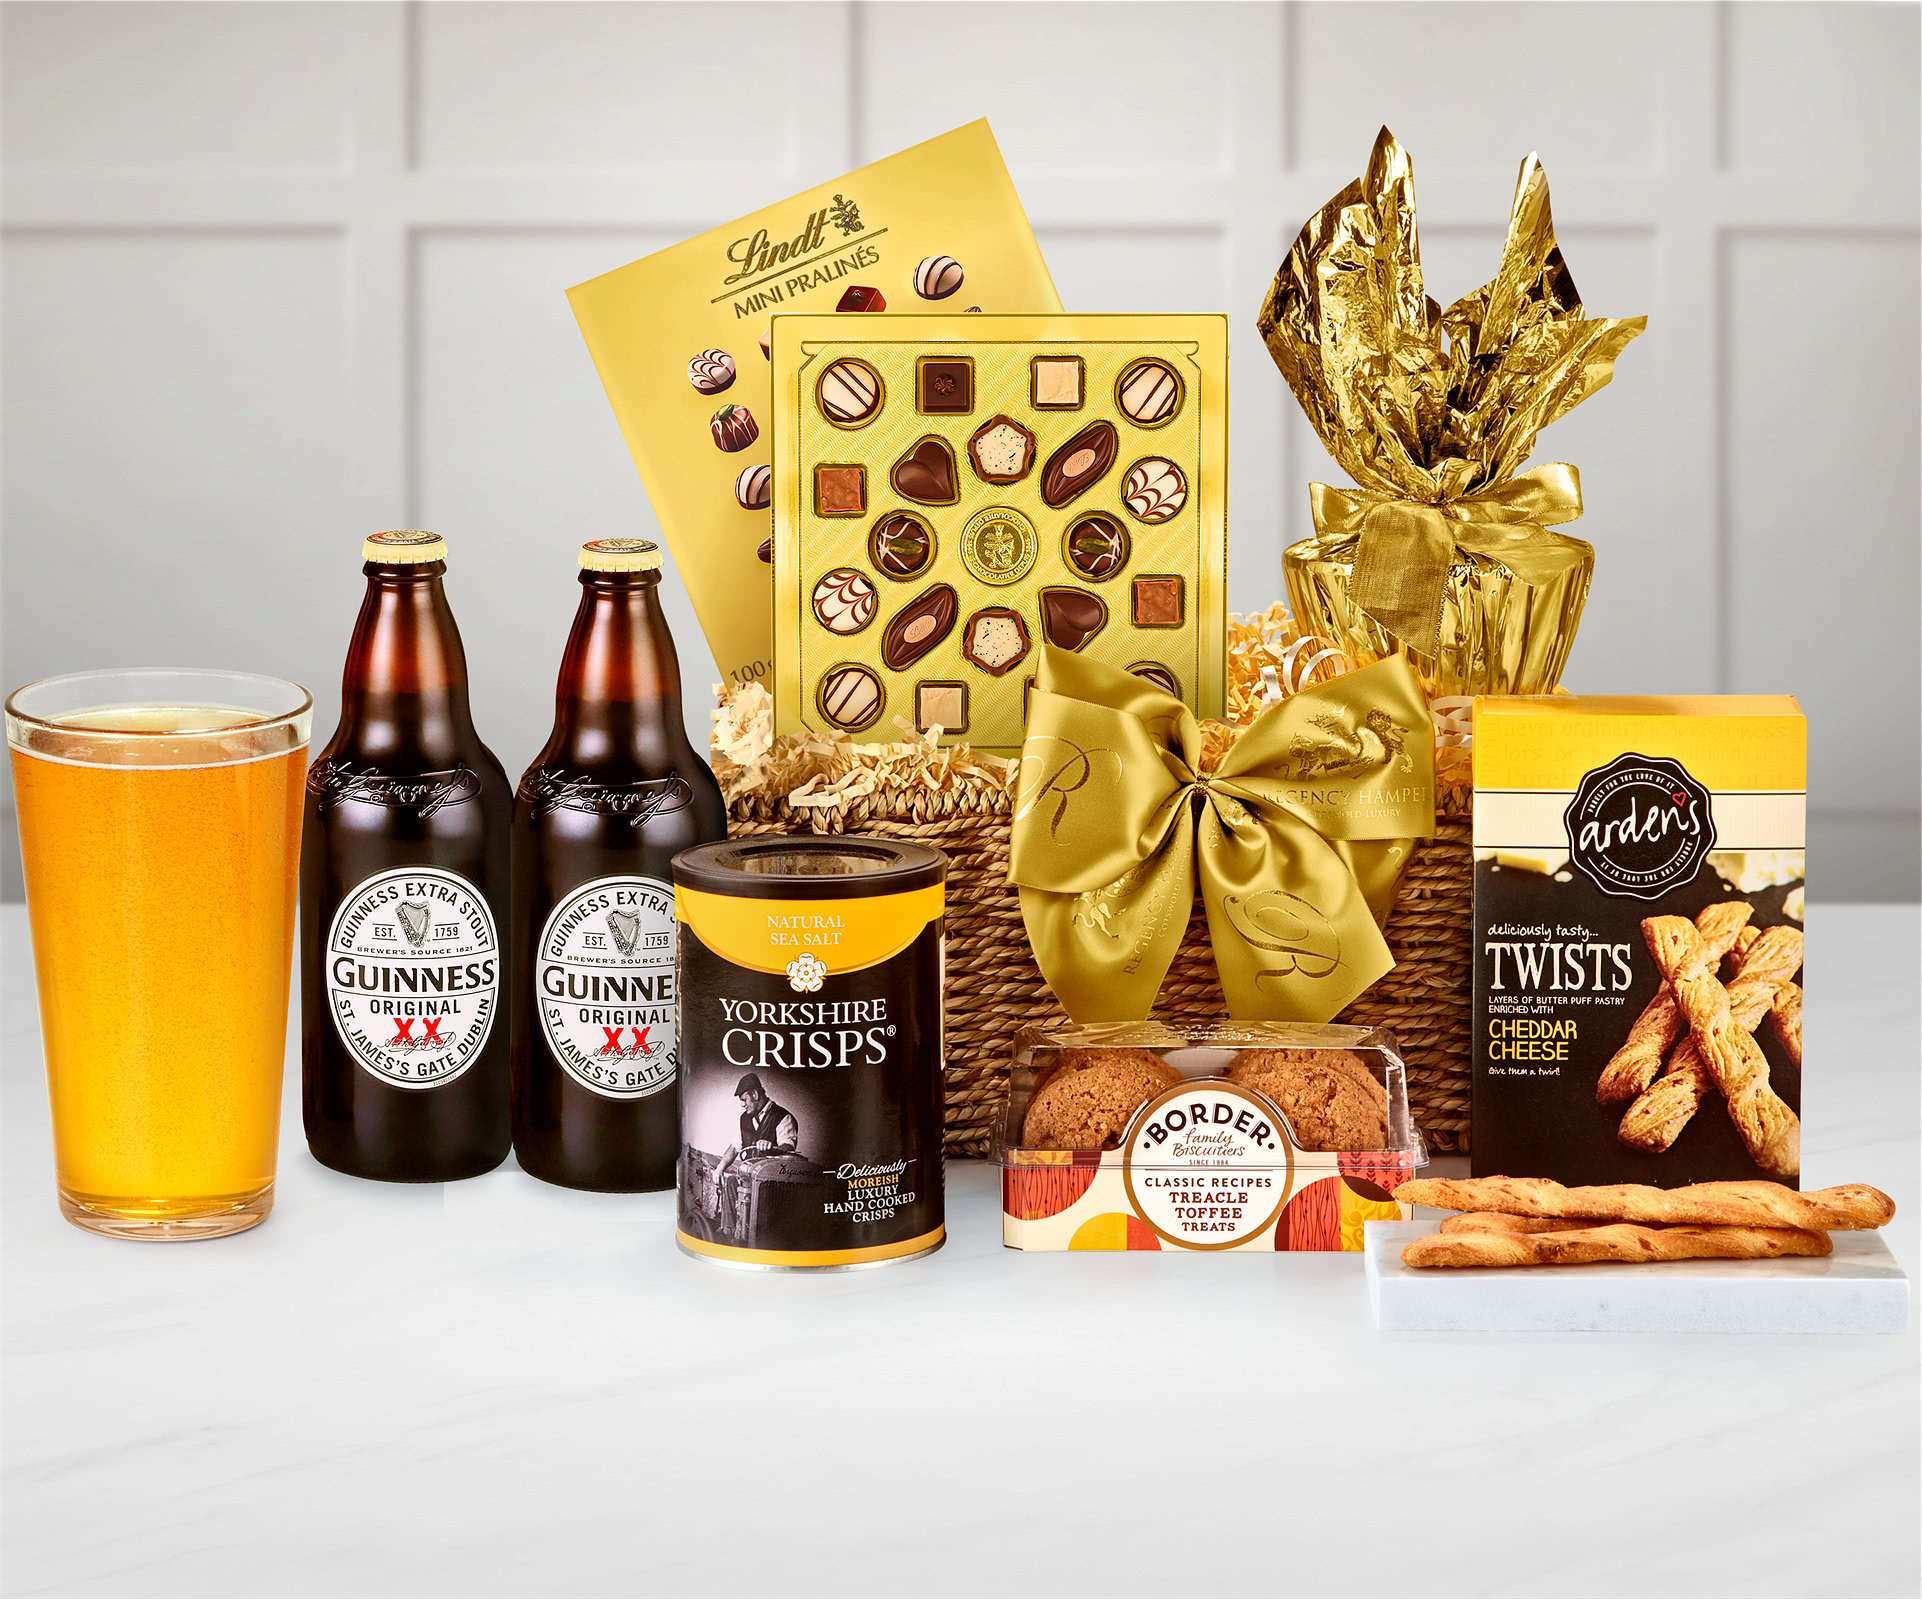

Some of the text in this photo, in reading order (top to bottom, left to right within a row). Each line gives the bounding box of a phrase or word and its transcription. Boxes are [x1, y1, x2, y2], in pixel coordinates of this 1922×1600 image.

[723, 208, 830, 285] Lindt
[734, 245, 880, 319] MINI PRALINÉS
[730, 661, 765, 682] 100
[1605, 779, 1619, 791] FOR
[1620, 773, 1633, 781] THE
[1636, 773, 1654, 781] LOVE
[1656, 776, 1665, 784] OF
[1667, 781, 1675, 790] IT
[1366, 808, 1401, 818] LUXURY
[1622, 873, 1641, 883] LOVE
[340, 882, 489, 949] GUINNESS EXTRA STOUT
[551, 891, 668, 957] GUINNESS EXTRA
[767, 915, 846, 929] NATURAL
[374, 926, 459, 938] EST. 1759
[770, 932, 842, 946] SEA SALT
[1487, 923, 1552, 942] deliciously
[585, 935, 670, 947] EST. 1759
[357, 946, 406, 956] BREWER'S
[411, 948, 451, 956] SOURCE
[567, 955, 616, 964] BREWER'S
[621, 957, 661, 965] SOURCE
[1485, 942, 1633, 991] TWISTS
[332, 956, 495, 993] GUINNESS
[542, 965, 673, 1002] GUINNE
[370, 999, 461, 1016] ORIGINAL
[1488, 996, 1626, 1006] LAYERS OF BUTTER PUFF PASTRY
[1488, 1005, 1554, 1014] ENRICHED WITH
[579, 1008, 670, 1025] ORIGINAL
[719, 998, 887, 1026] YORKSHIRE
[1488, 1018, 1578, 1039] CHEDDAR
[339, 999, 355, 1027] ST.
[351, 1028, 410, 1075] JAMES'S
[417, 1052, 457, 1077] GATE
[459, 998, 490, 1056] DUBLIN
[549, 1008, 565, 1036] ST.
[560, 1038, 619, 1085] JAMES'S
[625, 1062, 666, 1086] GATE
[1488, 1040, 1569, 1061] CHEESE
[1488, 1066, 1506, 1076] Give
[1508, 1066, 1528, 1076] them
[1529, 1068, 1537, 1076] a
[1145, 1103, 1271, 1147] BORDER
[1182, 1127, 1234, 1147] family
[1172, 1143, 1246, 1157] Biscuitiers
[836, 1158, 907, 1180] Deliciously
[848, 1174, 899, 1190] MOREISH
[1145, 1177, 1272, 1188] CLASSIC RECIPES
[848, 1184, 899, 1201] LUXURY
[1169, 1191, 1249, 1204] TREACLE
[823, 1191, 916, 1214] HAND COOKED
[852, 1207, 895, 1223] CRISPS
[1175, 1207, 1243, 1219] TOFFEE
[1181, 1222, 1237, 1232] TREATS
